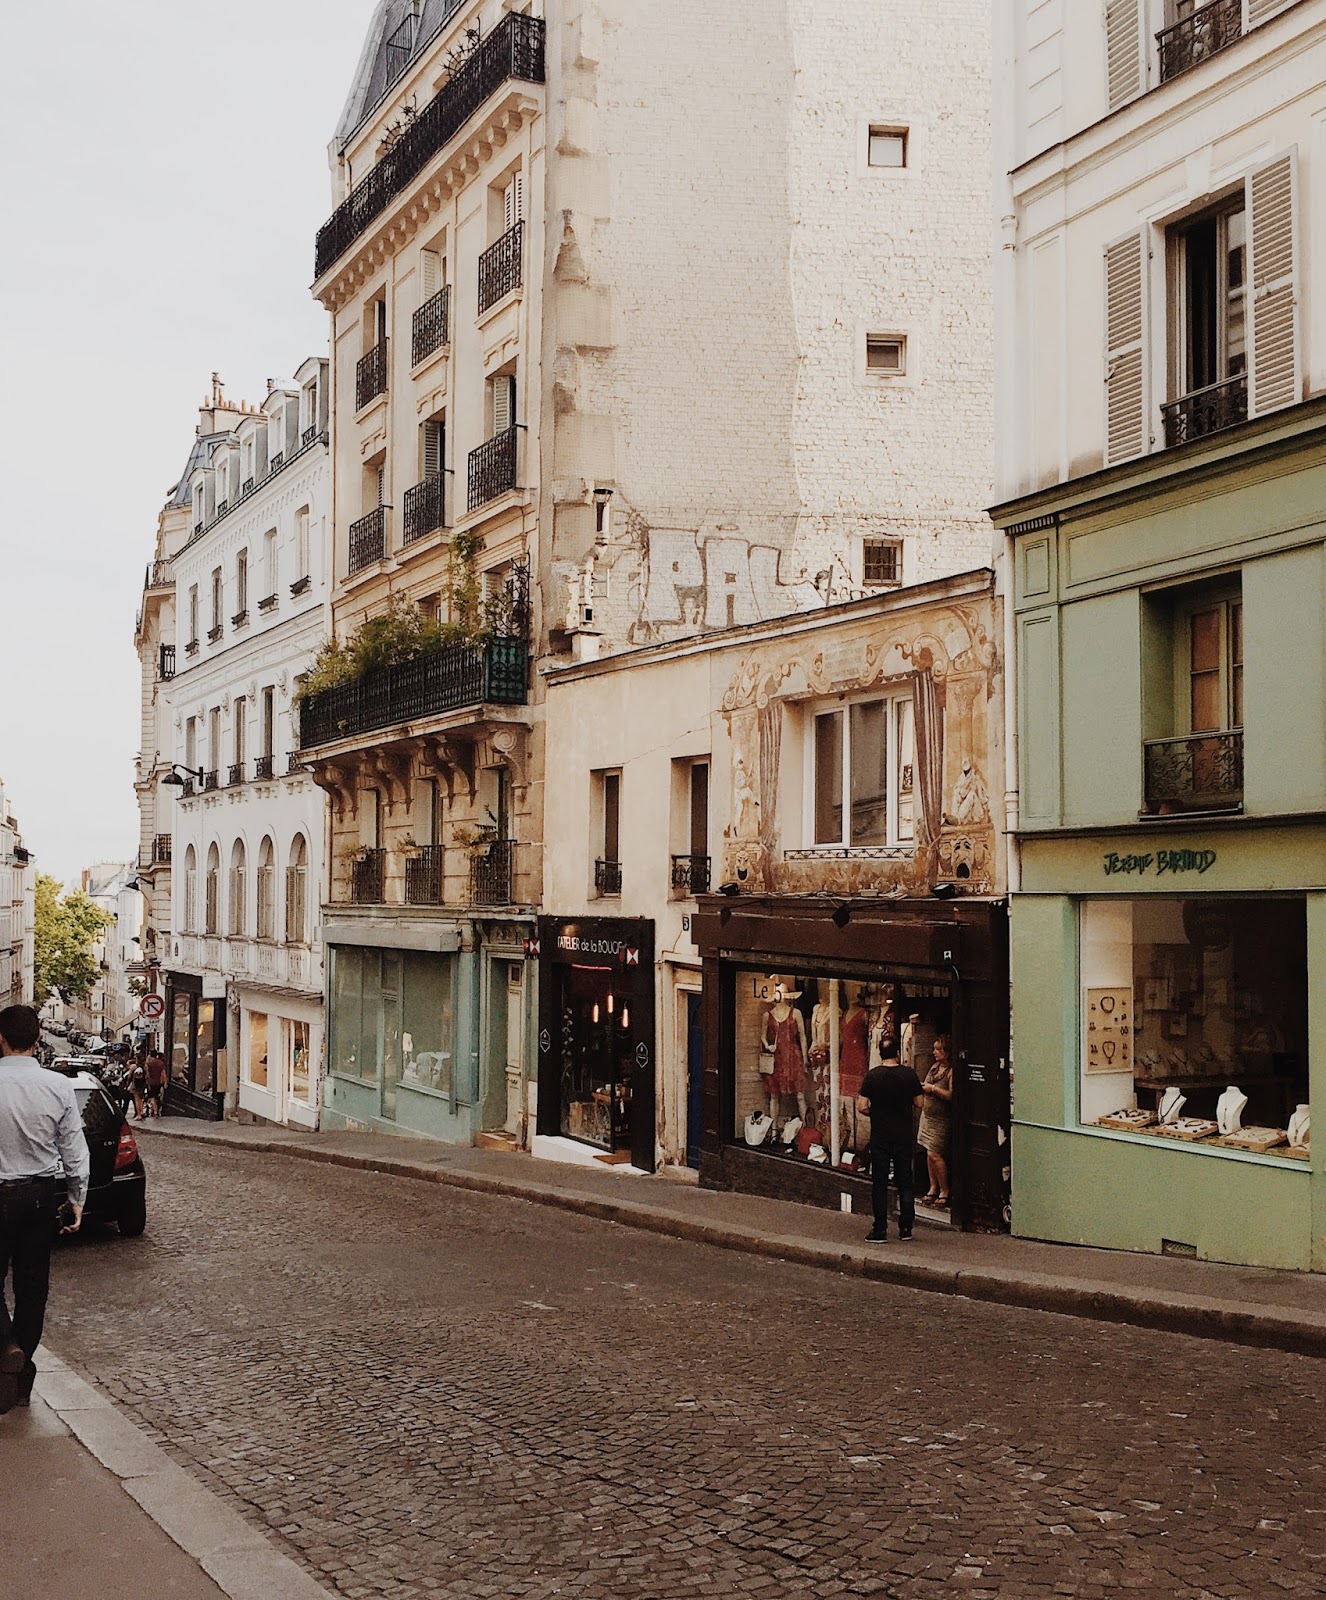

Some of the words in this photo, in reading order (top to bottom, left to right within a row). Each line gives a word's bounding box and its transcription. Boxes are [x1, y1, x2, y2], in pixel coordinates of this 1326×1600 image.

[683, 917, 690, 931] 5
[581, 938, 590, 952] de
[590, 939, 597, 953] la
[753, 978, 768, 999] Le
[774, 982, 782, 1004] 5
